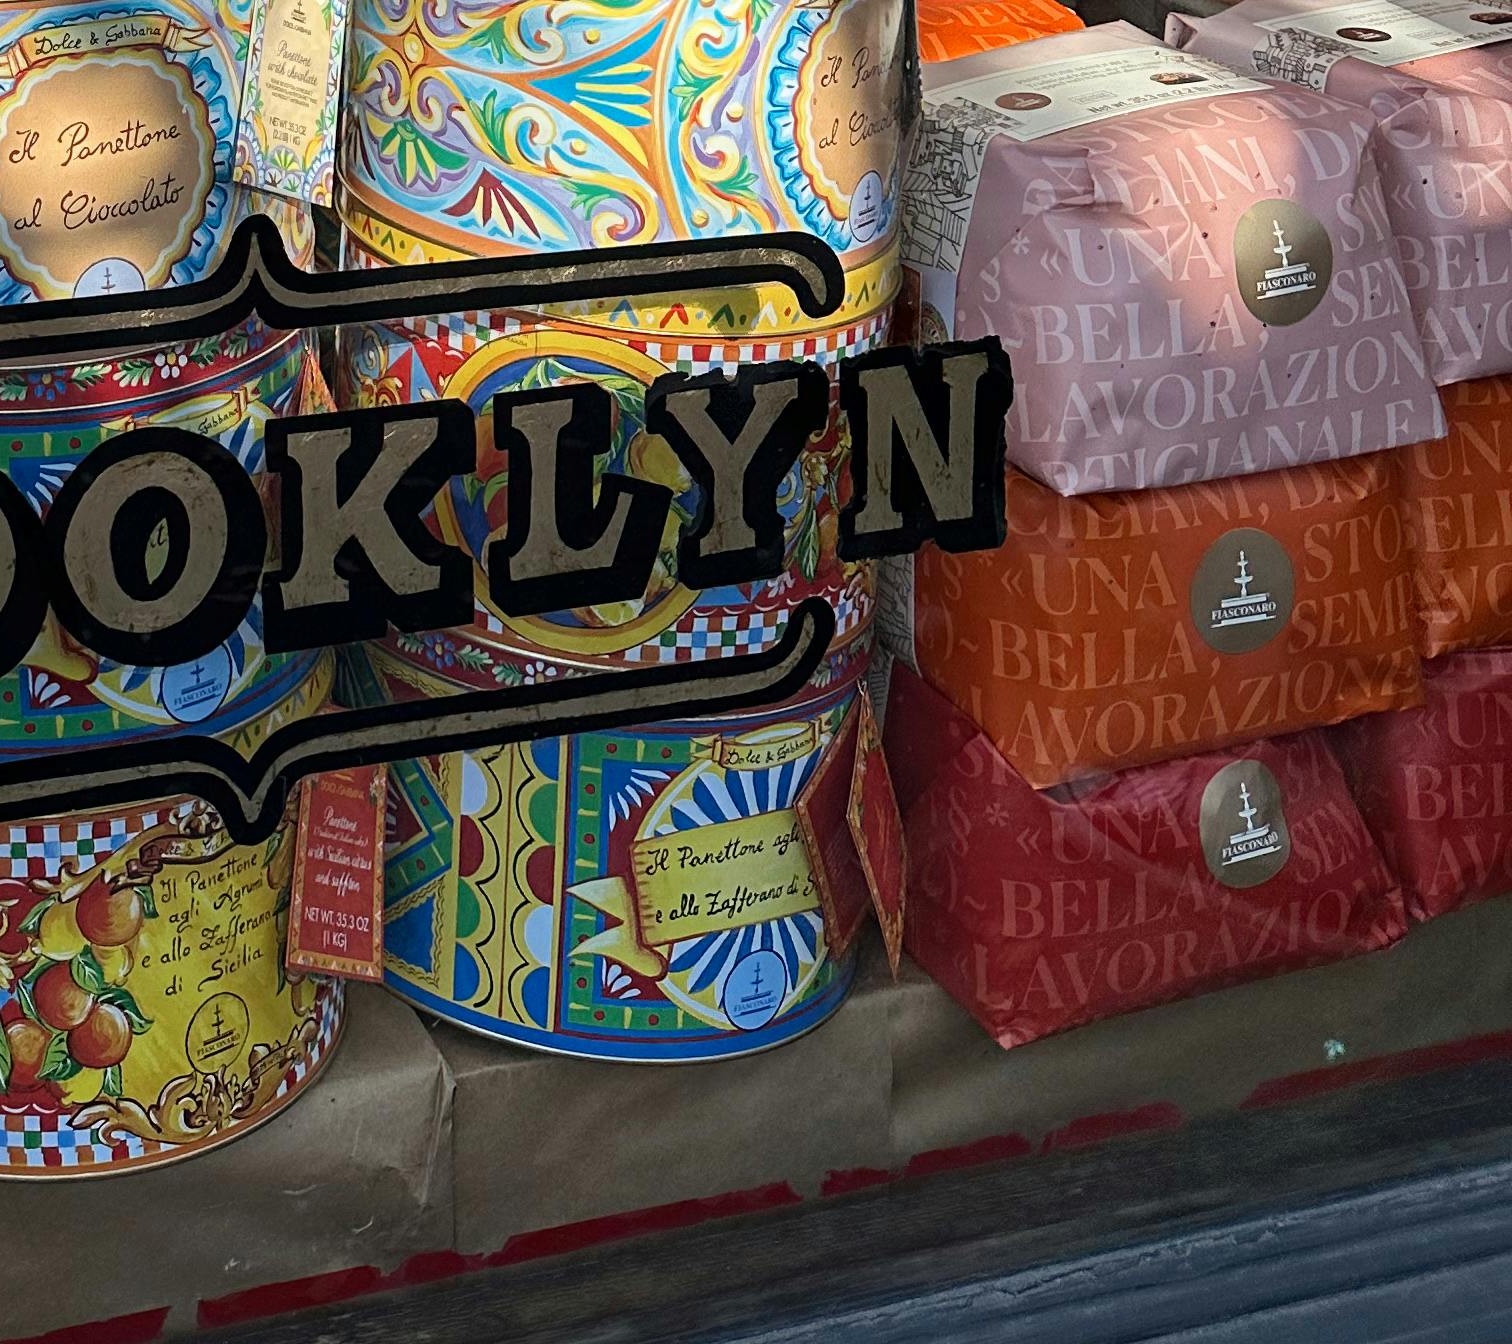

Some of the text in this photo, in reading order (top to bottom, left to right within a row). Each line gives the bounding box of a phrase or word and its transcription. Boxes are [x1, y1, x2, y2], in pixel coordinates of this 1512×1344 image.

[33, 21, 162, 57] Dolce & Gabbana
[57, 120, 181, 169] Panettone
[819, 119, 839, 149] al
[13, 179, 186, 232] al Cioccolato
[1256, 270, 1318, 294] FIASCONARO
[1031, 291, 1270, 366] BELLA,
[1210, 601, 1277, 622] FIASCONARO
[987, 612, 1220, 692] BELLA,
[173, 681, 224, 707] FIASCONARO
[726, 746, 762, 766] Dolce
[323, 805, 359, 833] Panettone
[675, 838, 766, 872] Panettone
[1221, 830, 1279, 860] FIASCONARO
[187, 852, 259, 893] Panettone
[169, 871, 264, 934] agli Agrumi
[655, 908, 664, 925] e
[705, 886, 784, 919] Zafferano
[785, 874, 800, 898] di
[304, 905, 320, 922] NET
[336, 911, 355, 931] 35.3
[355, 916, 370, 933] OZ
[141, 908, 276, 969] e allo Zafferano
[332, 930, 348, 953] KG)
[165, 942, 265, 997] di Sicilia
